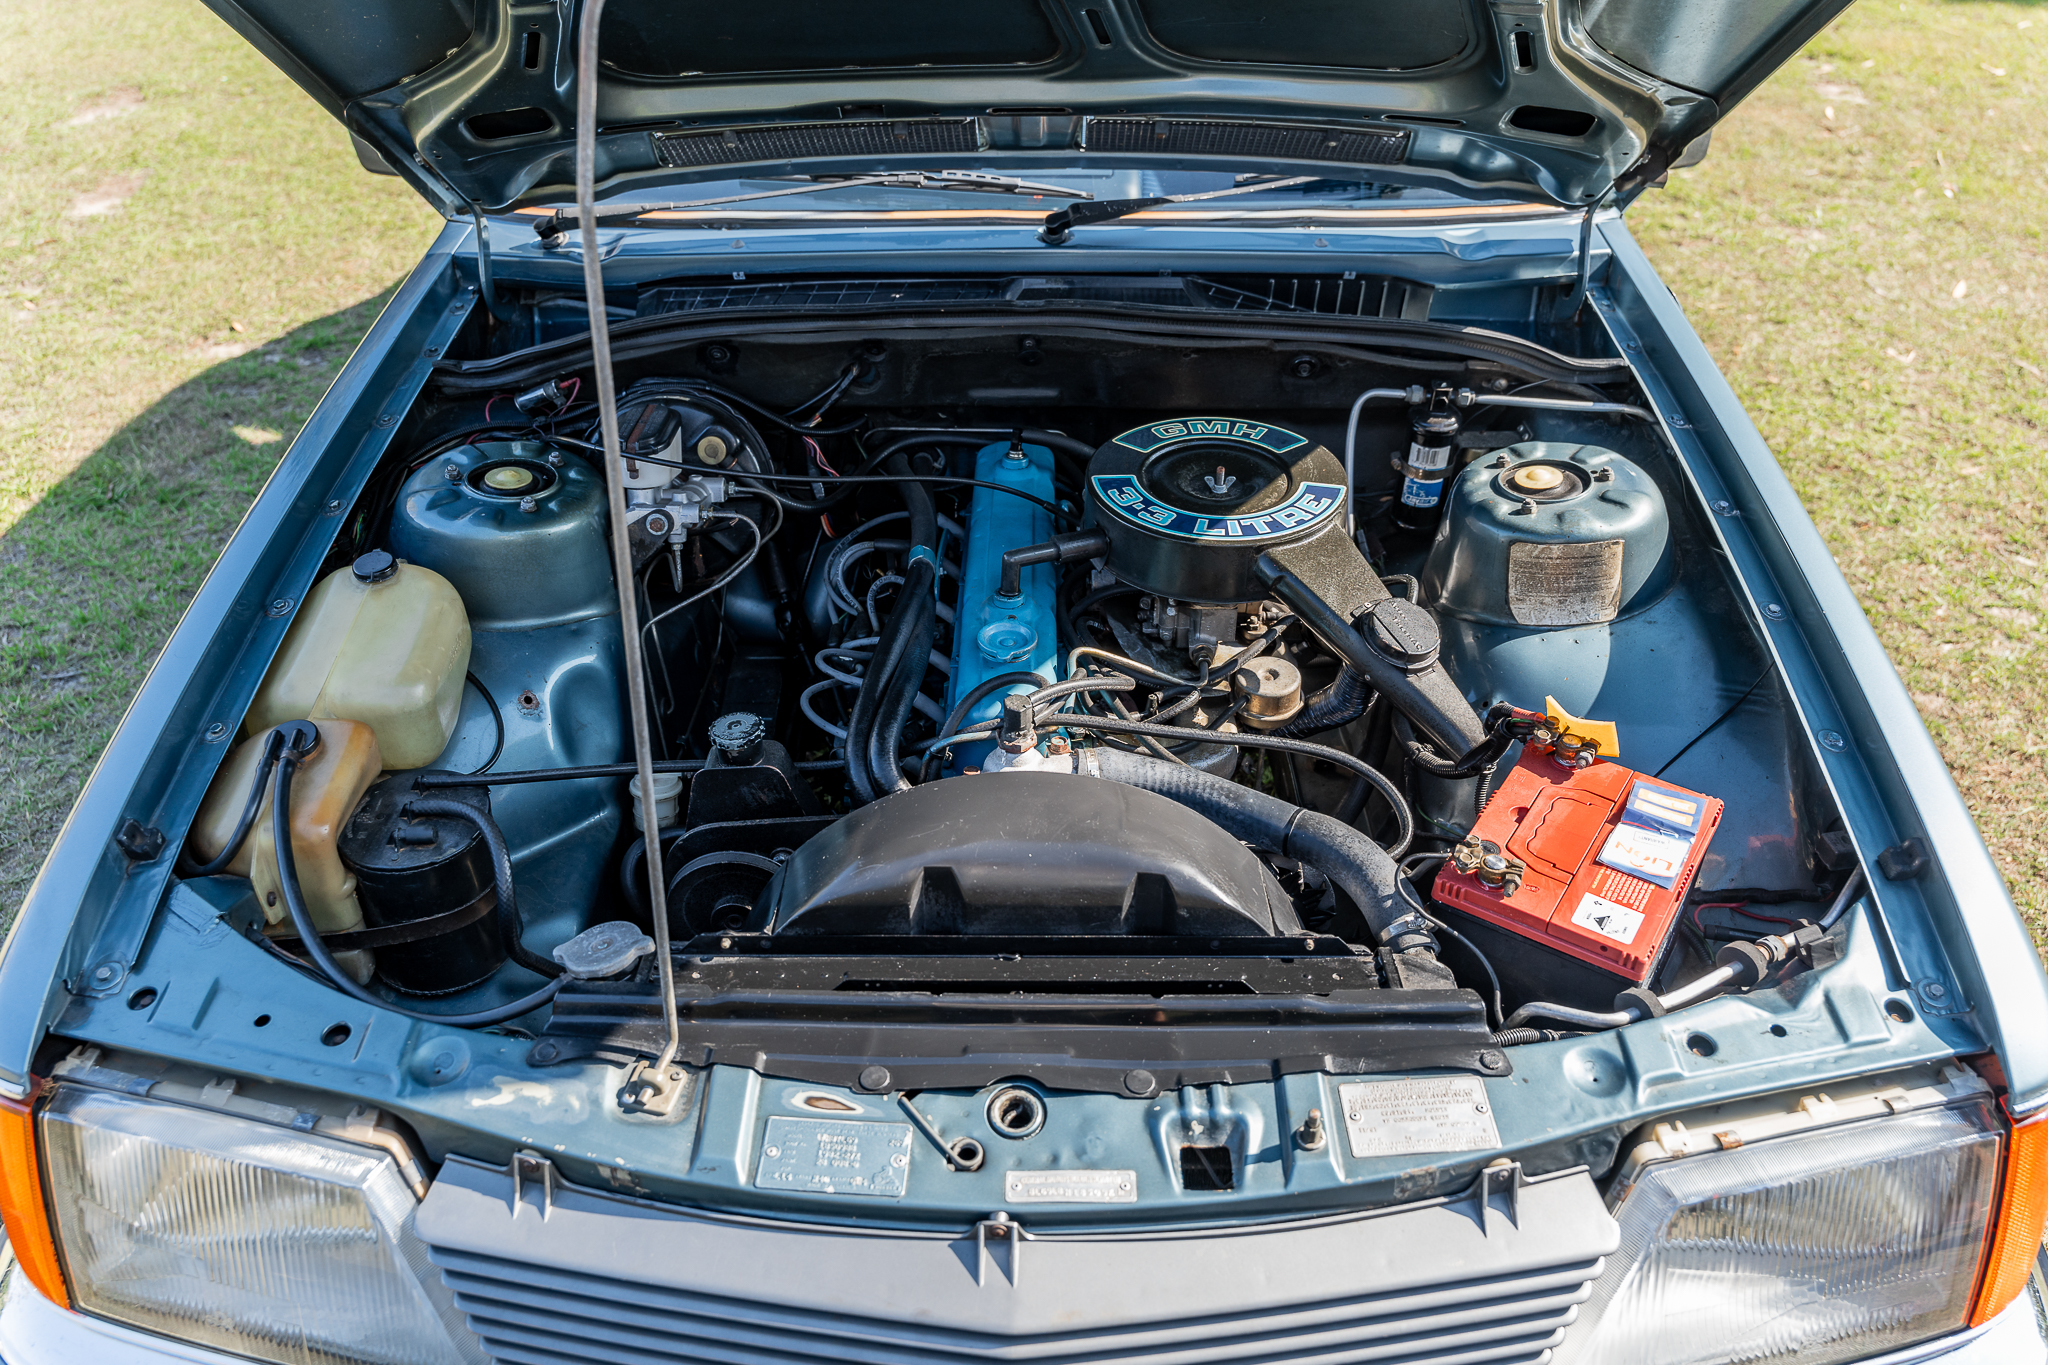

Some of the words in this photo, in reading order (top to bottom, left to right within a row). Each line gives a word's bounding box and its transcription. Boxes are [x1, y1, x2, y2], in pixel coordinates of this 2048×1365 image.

[1151, 420, 1269, 440] GMH
[1192, 493, 1334, 537] LITRE
[1614, 840, 1674, 872] LION
